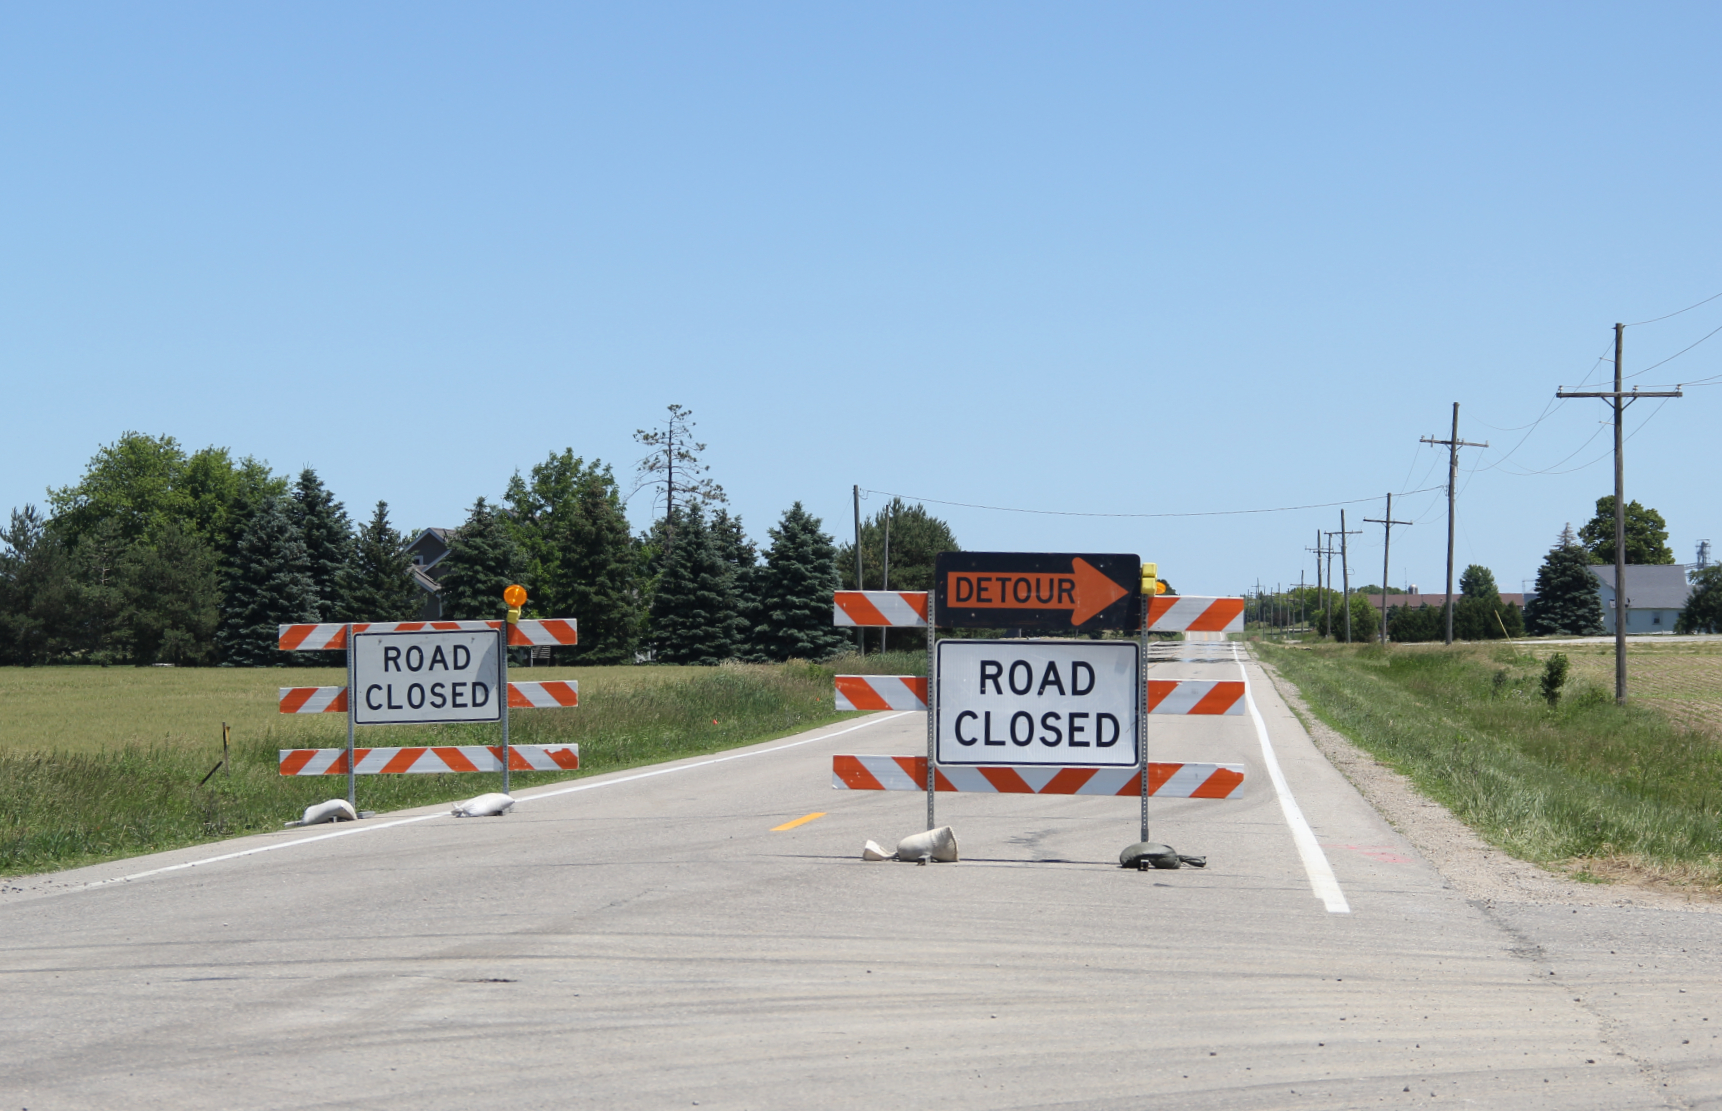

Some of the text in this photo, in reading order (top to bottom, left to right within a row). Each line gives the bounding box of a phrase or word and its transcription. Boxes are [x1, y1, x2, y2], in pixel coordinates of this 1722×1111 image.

[956, 576, 1076, 604] DETOUR
[384, 644, 471, 672] ROAD
[980, 659, 1096, 697] ROAD
[365, 681, 489, 711] CLOSED
[954, 709, 1121, 748] CLOSED
